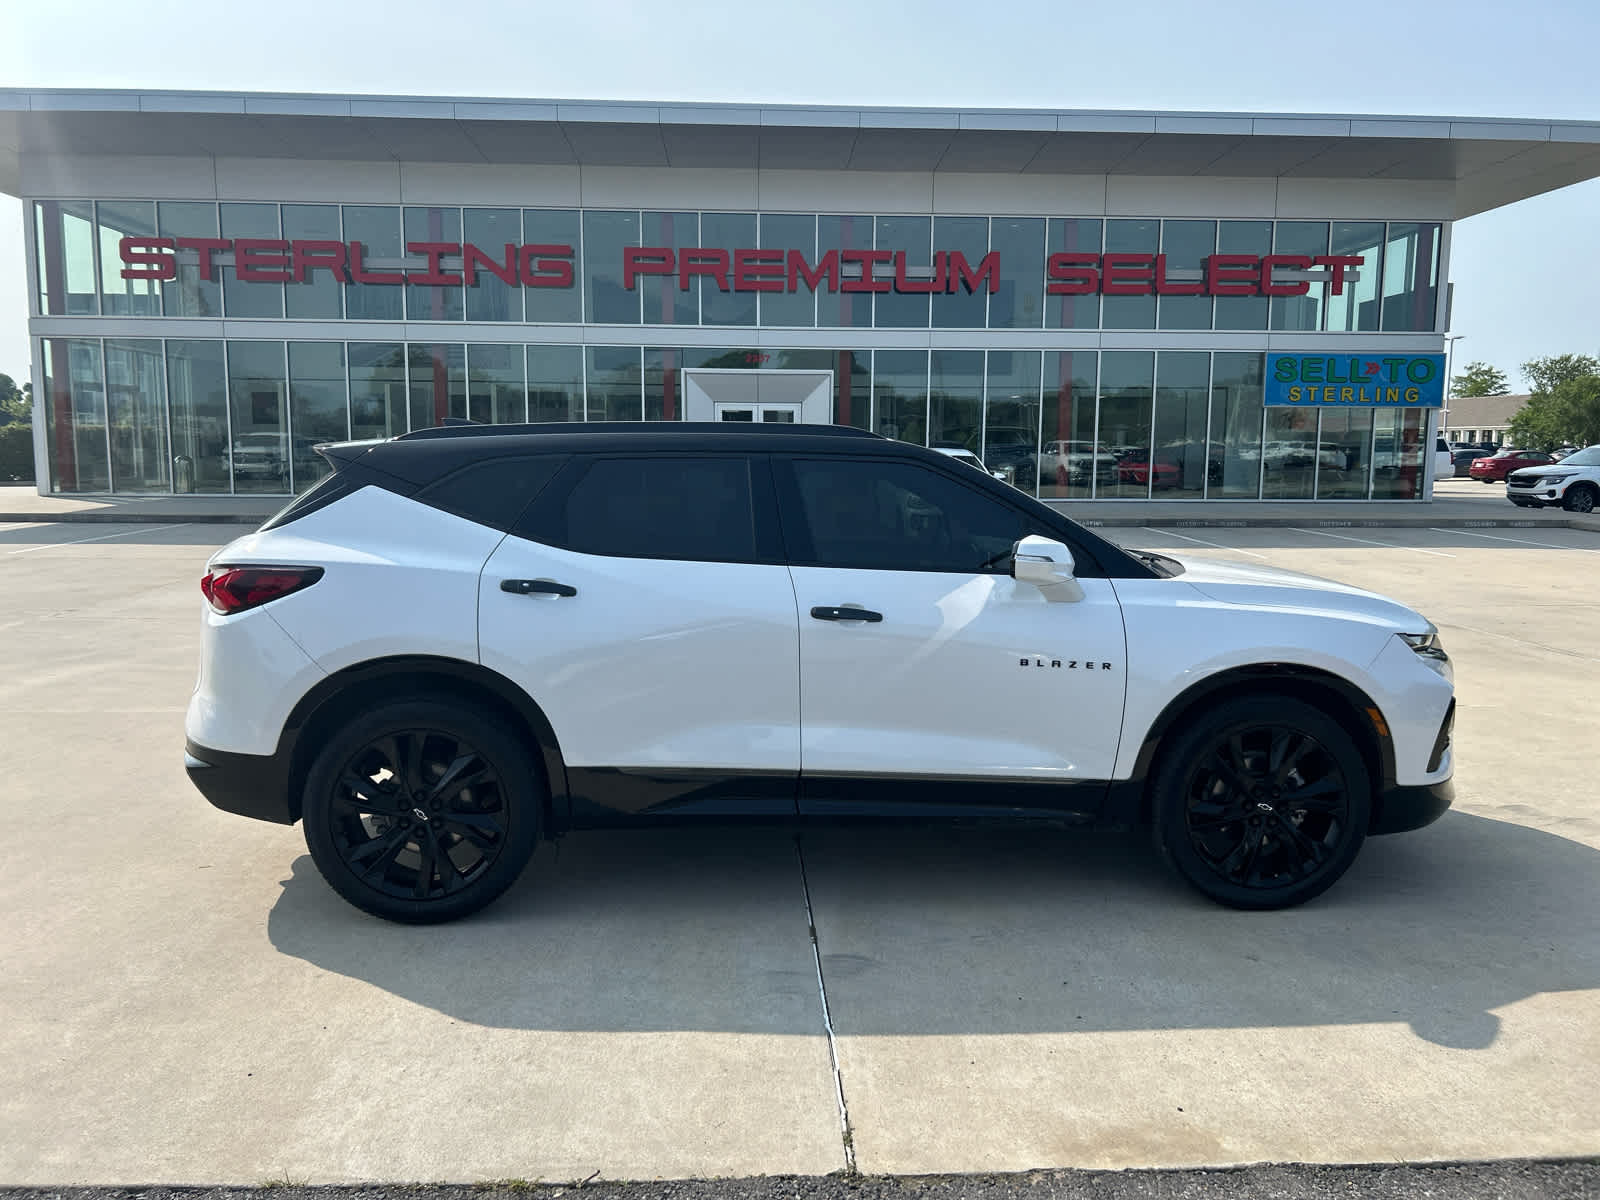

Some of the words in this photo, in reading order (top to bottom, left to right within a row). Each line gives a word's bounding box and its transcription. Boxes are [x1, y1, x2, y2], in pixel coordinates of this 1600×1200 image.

[119, 237, 575, 288] STERLING
[623, 246, 1001, 294] PREMIUM
[1047, 252, 1366, 297] SELECT
[1274, 356, 1373, 384] SELL
[1382, 357, 1437, 384] TO
[1288, 386, 1420, 403] STERLING
[1019, 658, 1112, 671] BLAZER
